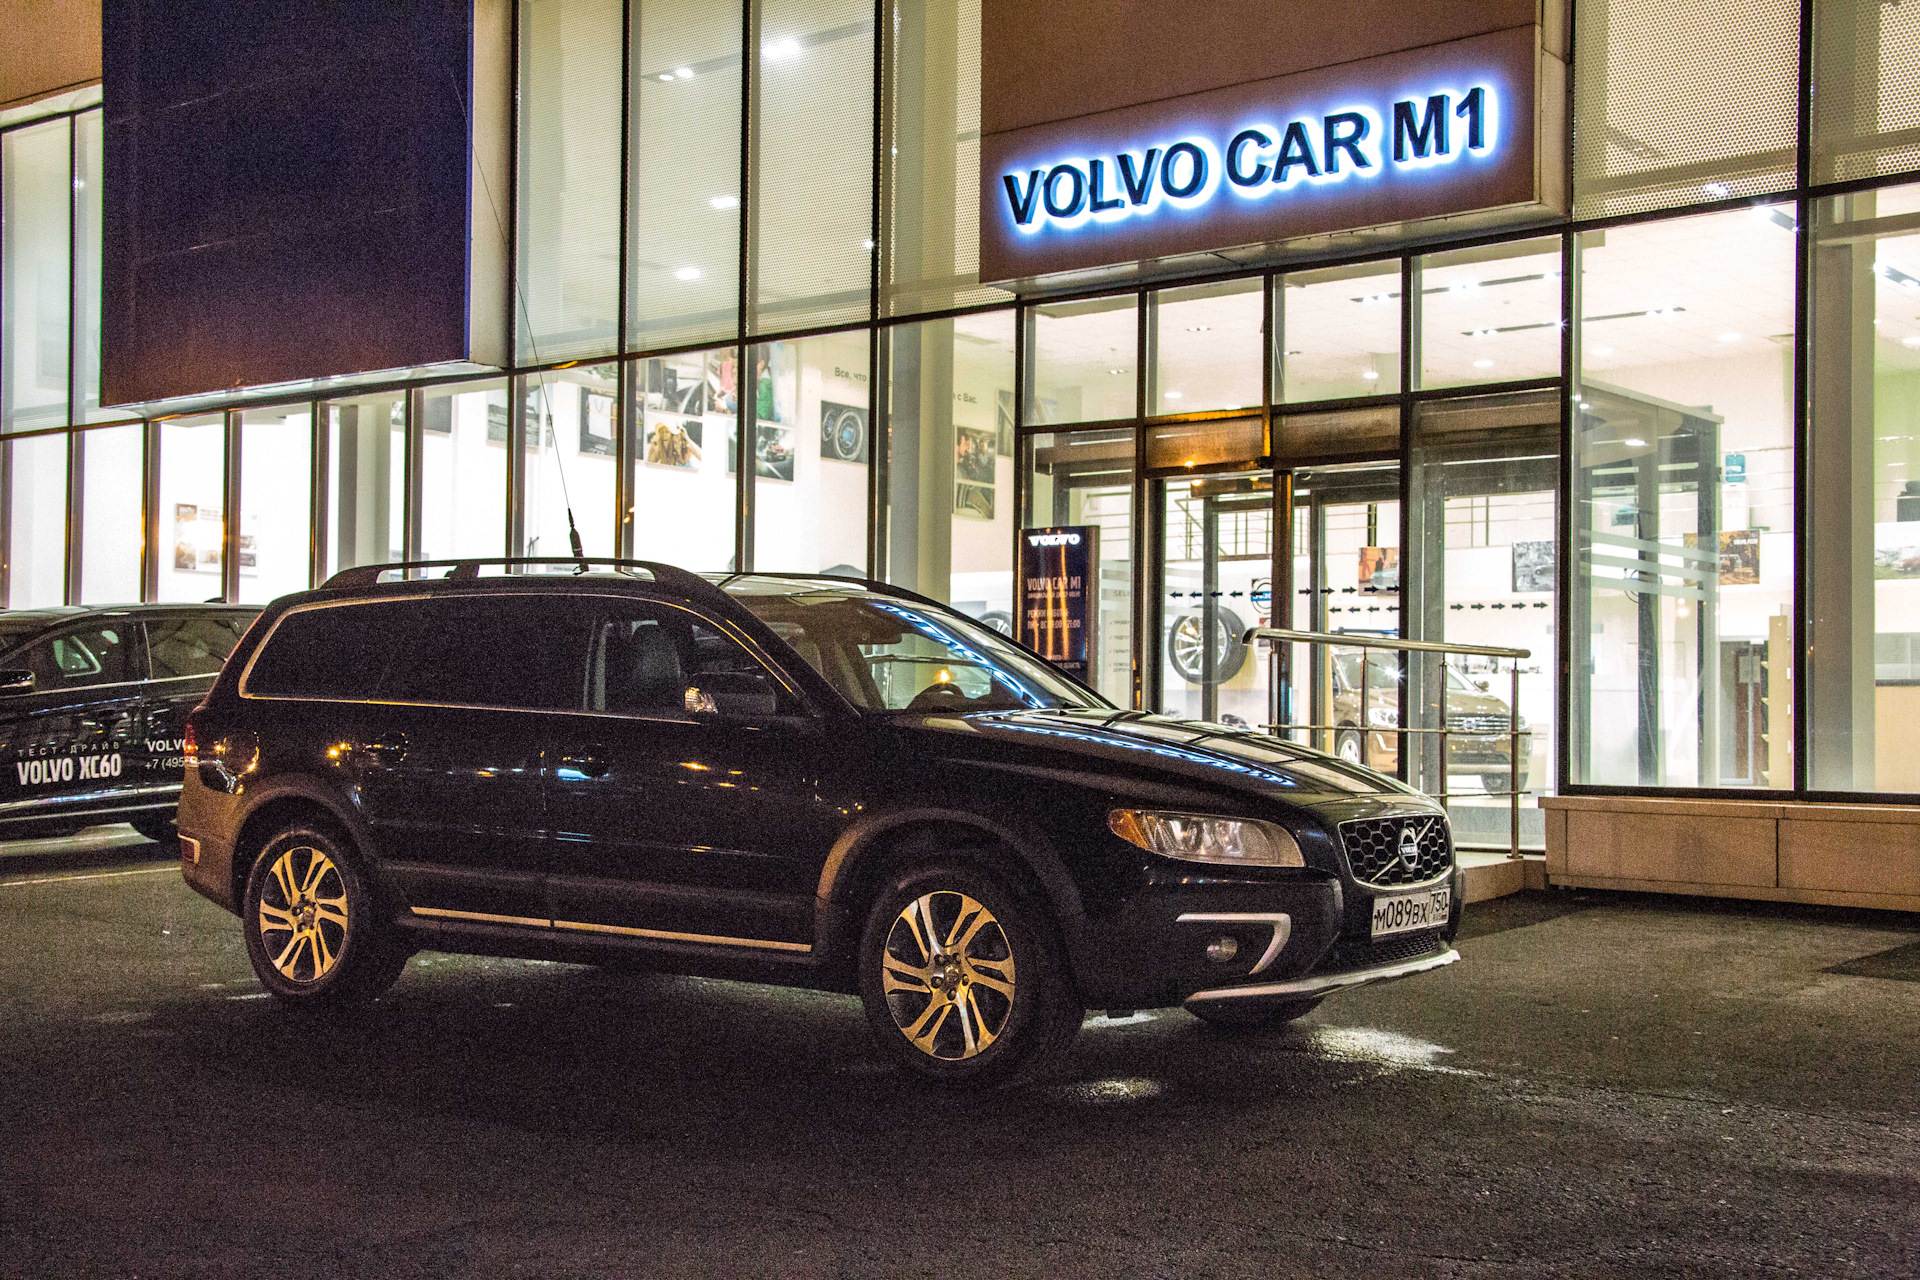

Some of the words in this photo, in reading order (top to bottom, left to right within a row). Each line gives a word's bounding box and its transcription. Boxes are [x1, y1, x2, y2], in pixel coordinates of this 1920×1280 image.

[1002, 141, 1208, 226] VOLVO
[1226, 111, 1372, 187] CAR
[1393, 86, 1486, 163] M1
[853, 372, 868, 382] что
[1028, 533, 1081, 547] VOLVO
[1027, 577, 1052, 591] VOLVO
[1052, 576, 1069, 590] CAR
[1070, 575, 1081, 590] M1
[17, 757, 74, 785] VOLVO
[79, 753, 122, 780] XC60
[145, 758, 159, 770] +7
[1430, 891, 1448, 914] 750
